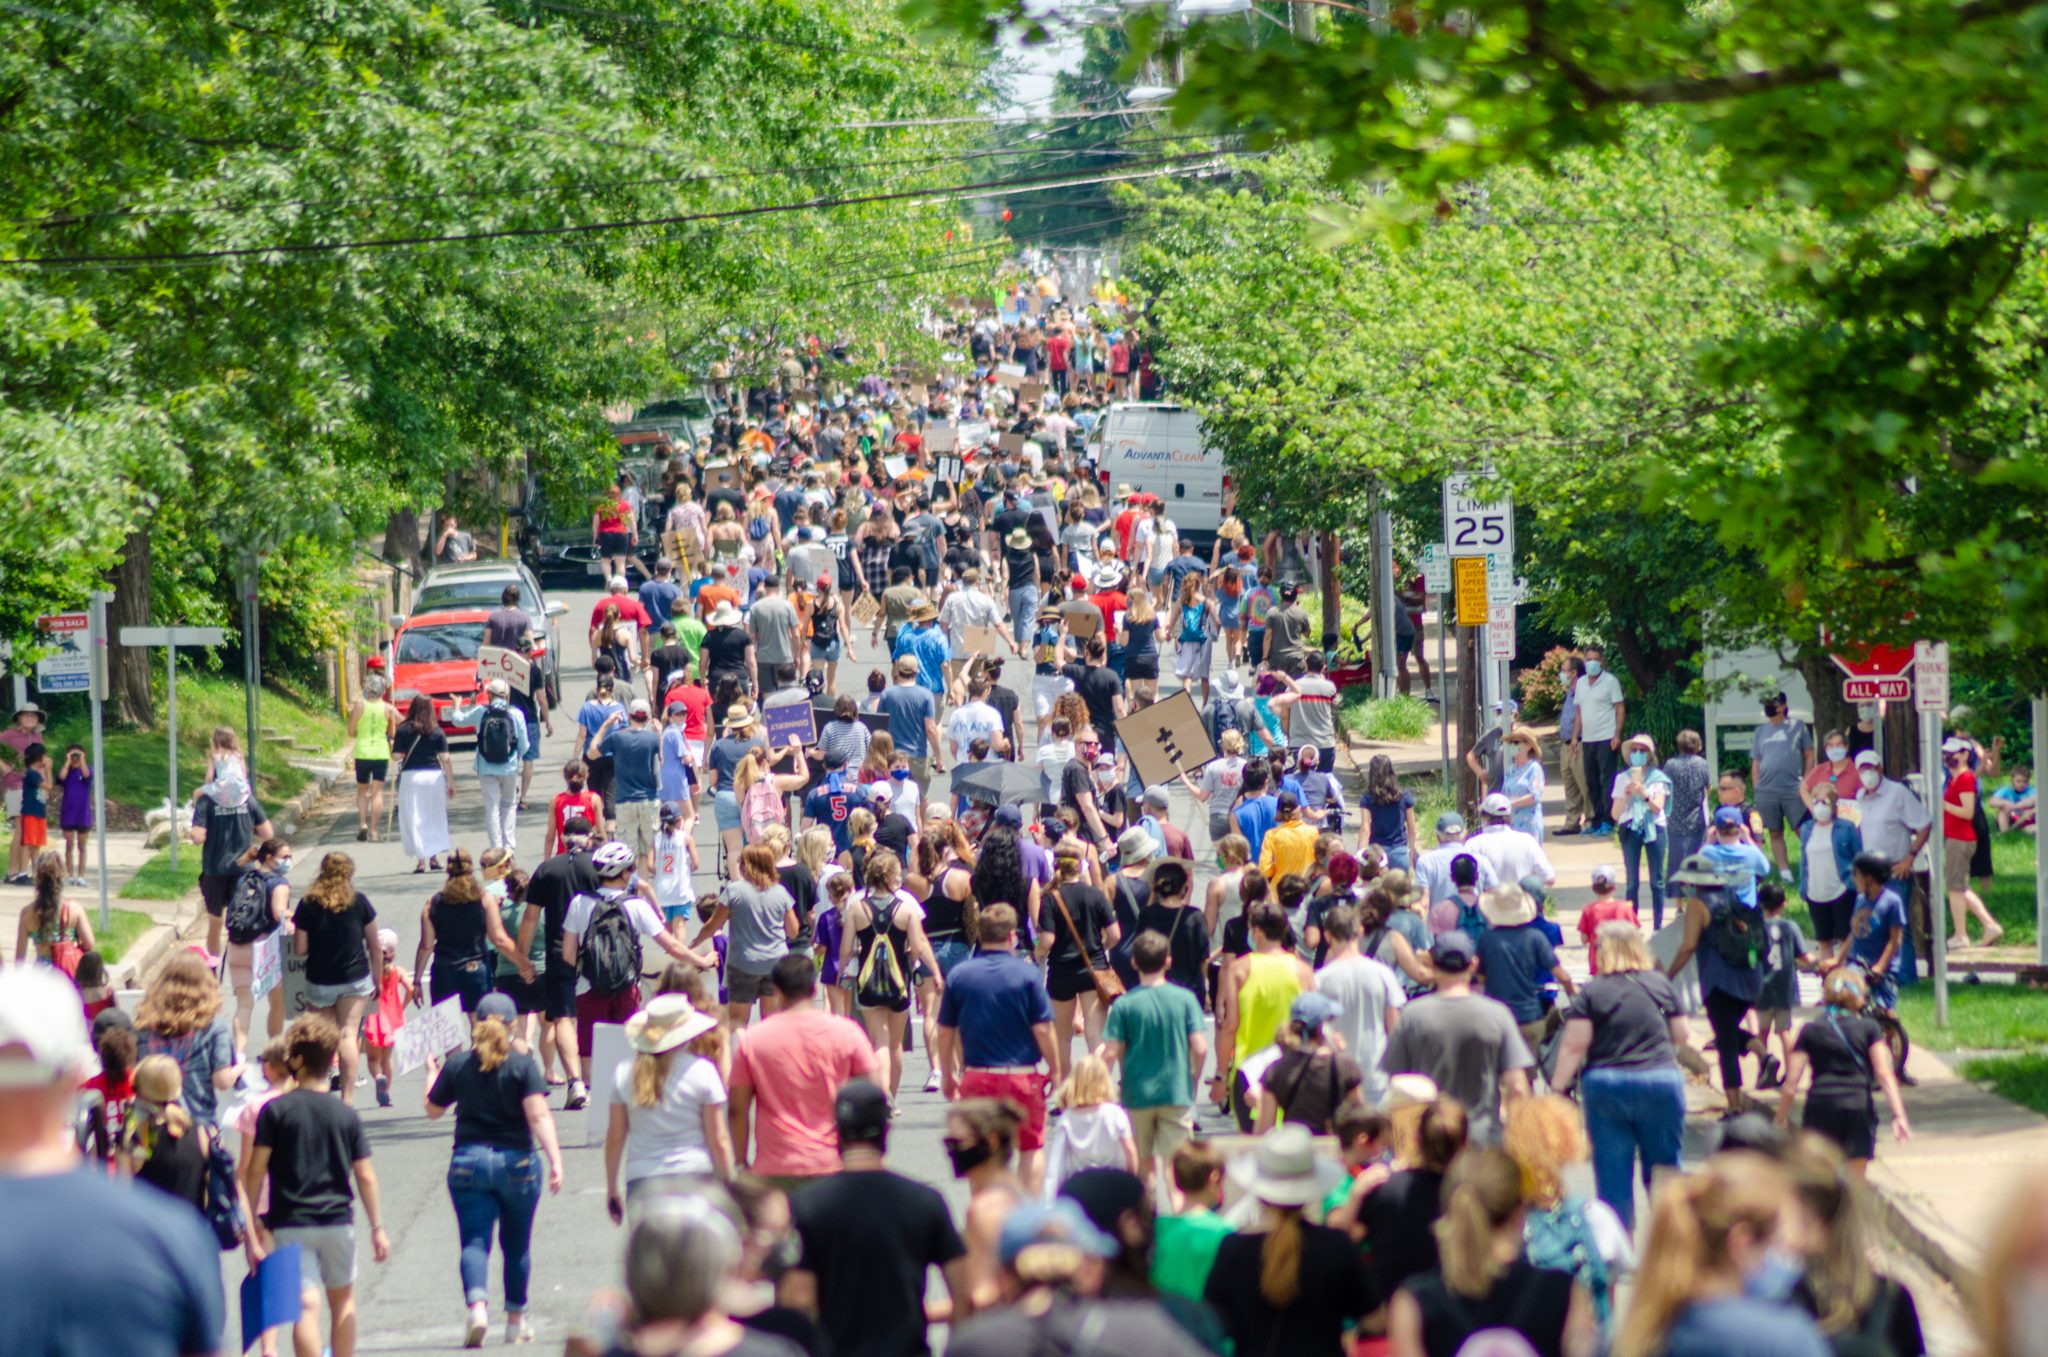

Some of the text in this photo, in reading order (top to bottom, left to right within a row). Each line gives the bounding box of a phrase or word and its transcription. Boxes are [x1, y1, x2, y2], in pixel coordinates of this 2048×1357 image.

[1455, 515, 1505, 546] 25
[65, 619, 85, 627] SALE
[1495, 609, 1506, 620] NO
[500, 652, 513, 672] 6
[1849, 682, 1904, 697] ALL WAY
[830, 794, 848, 821] 5
[663, 854, 674, 873] 2
